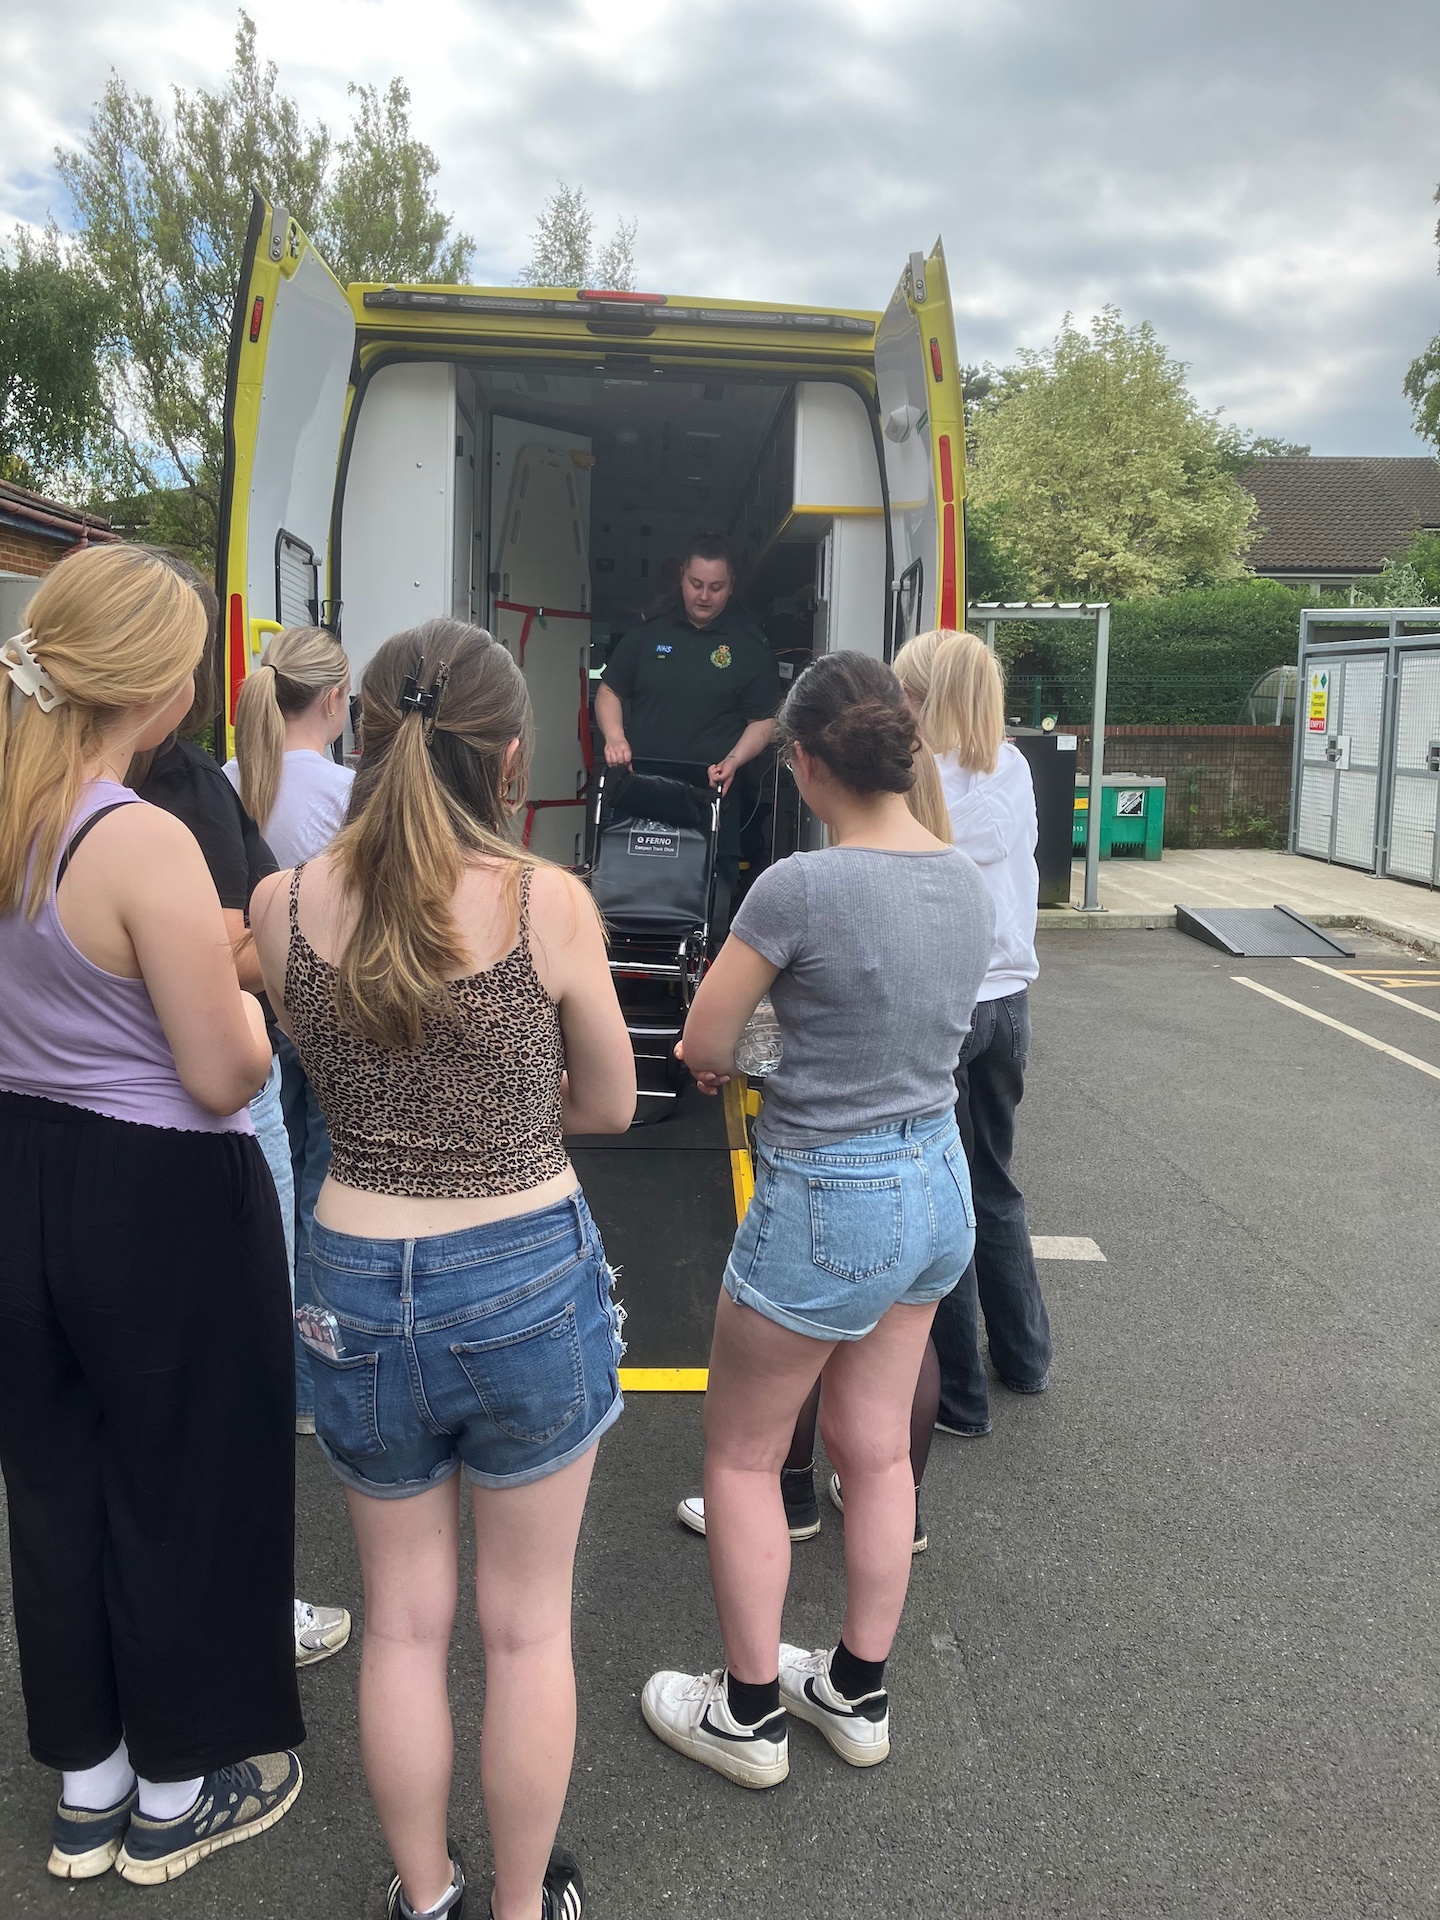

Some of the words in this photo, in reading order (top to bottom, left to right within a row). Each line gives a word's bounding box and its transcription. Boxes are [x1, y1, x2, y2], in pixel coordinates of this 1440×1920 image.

[656, 645, 673, 653] NHS
[1310, 720, 1324, 728] EMPTY
[645, 837, 671, 845] FERNO
